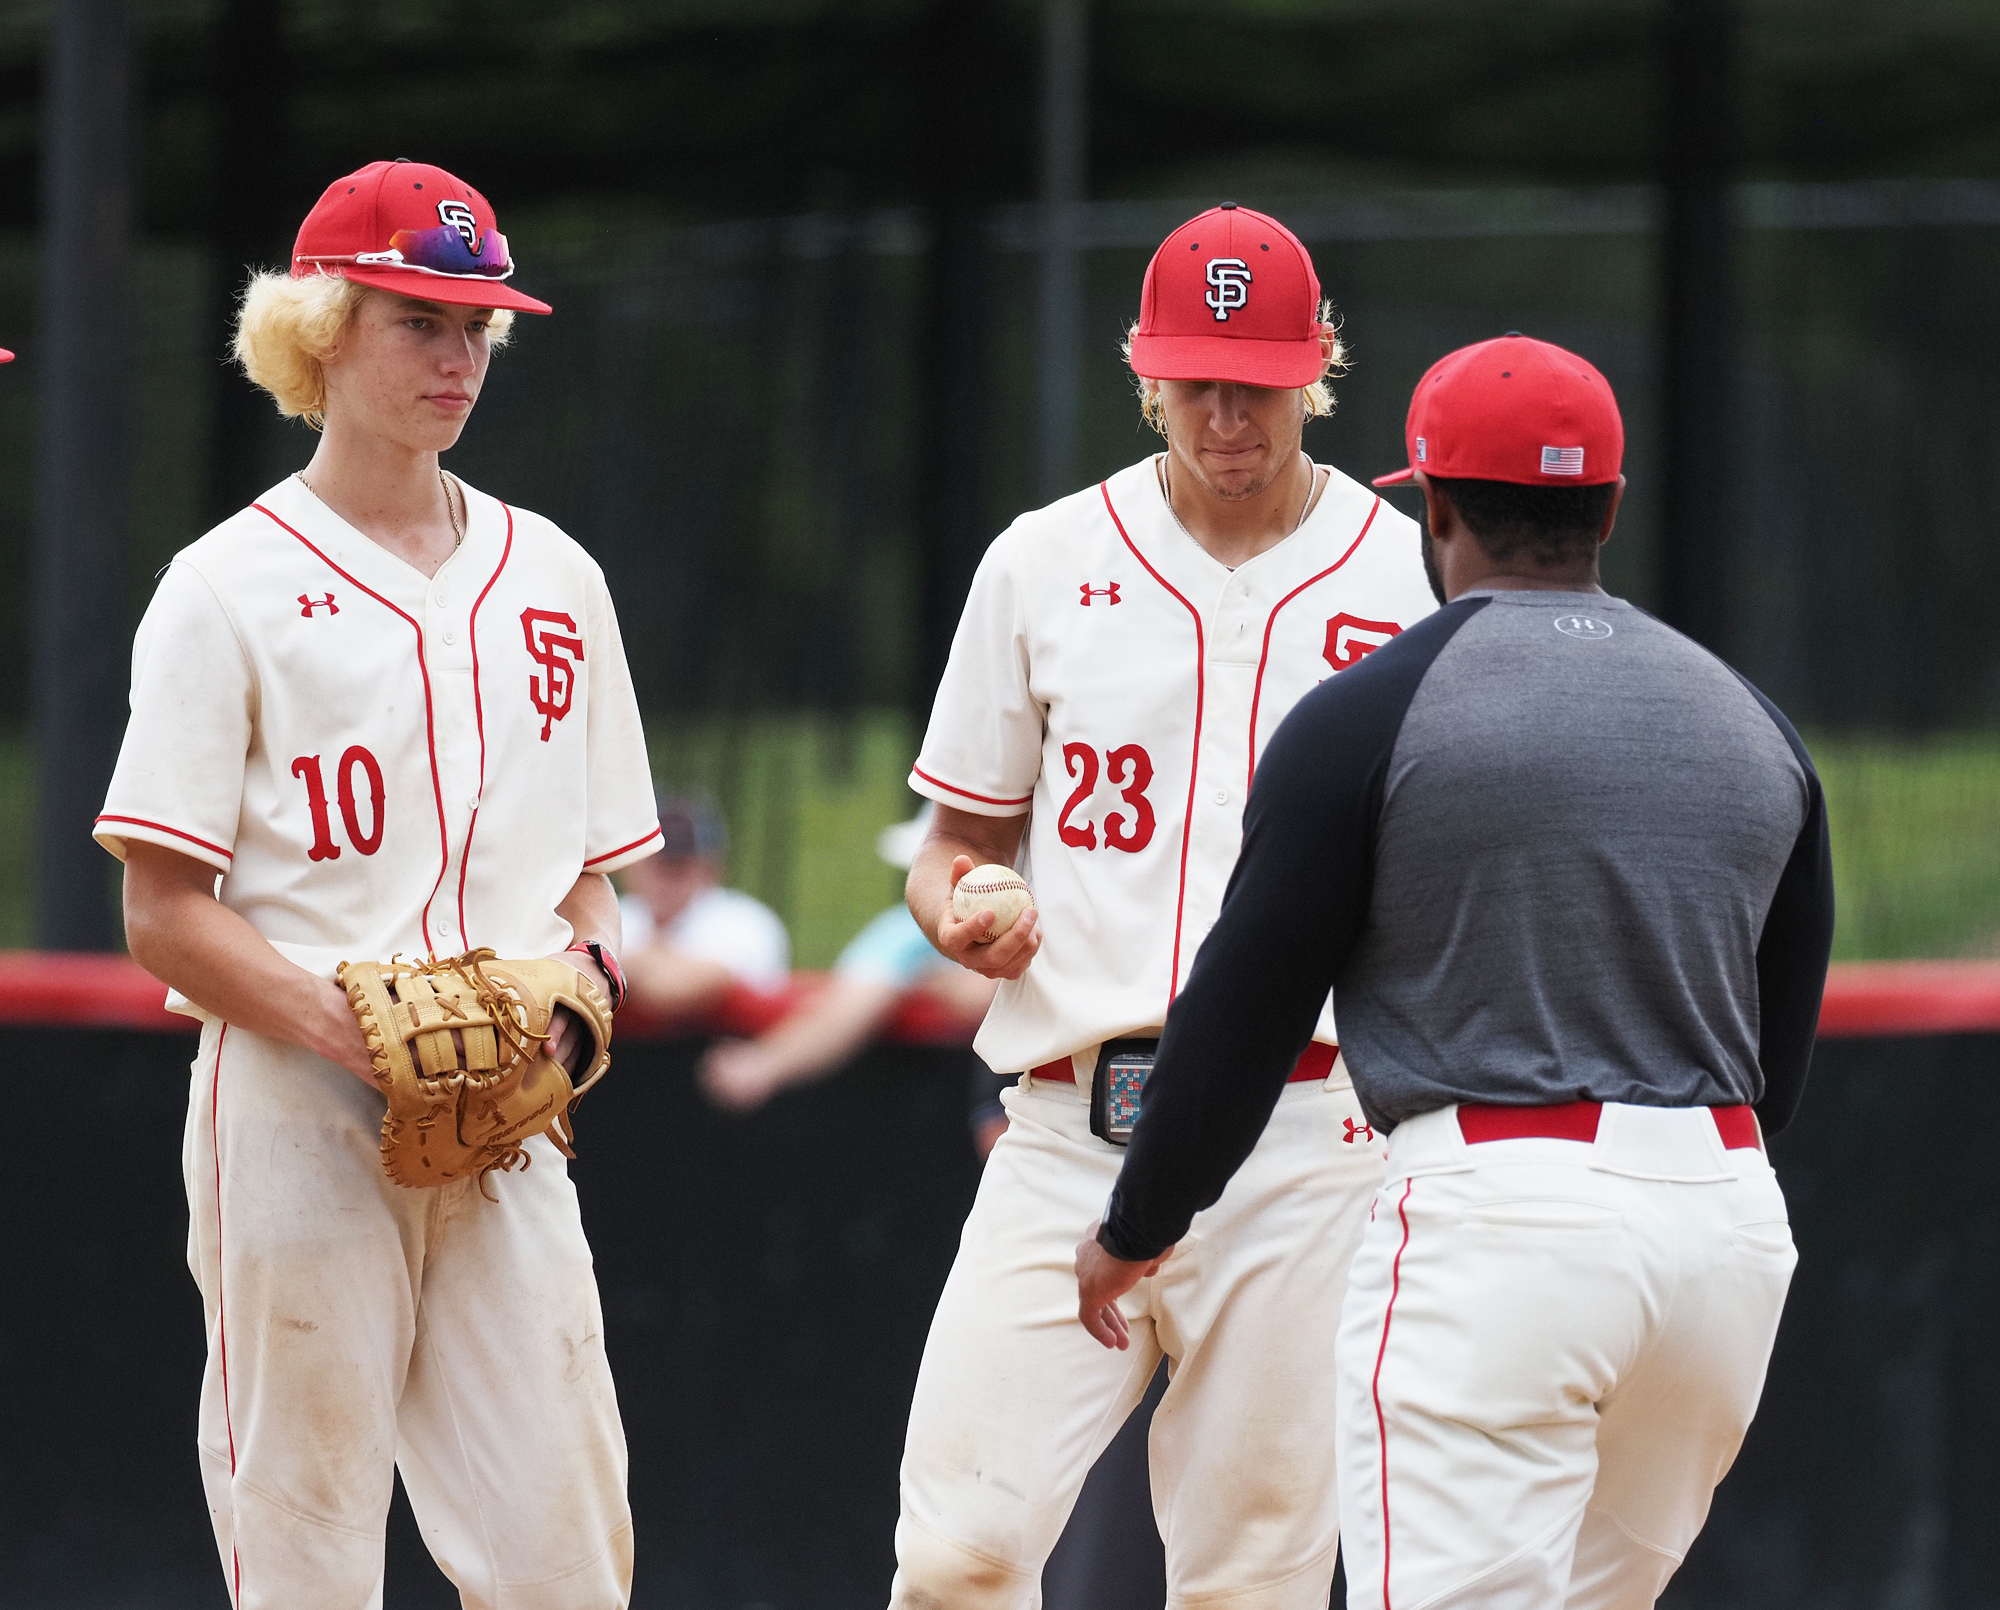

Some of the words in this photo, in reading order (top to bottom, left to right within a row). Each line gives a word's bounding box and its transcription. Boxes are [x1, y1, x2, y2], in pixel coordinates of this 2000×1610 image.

[1205, 257, 1252, 321] SF
[519, 606, 585, 743] SF
[291, 744, 386, 863] 10
[1057, 741, 1157, 854] 23
[484, 1092, 555, 1146] marucci
